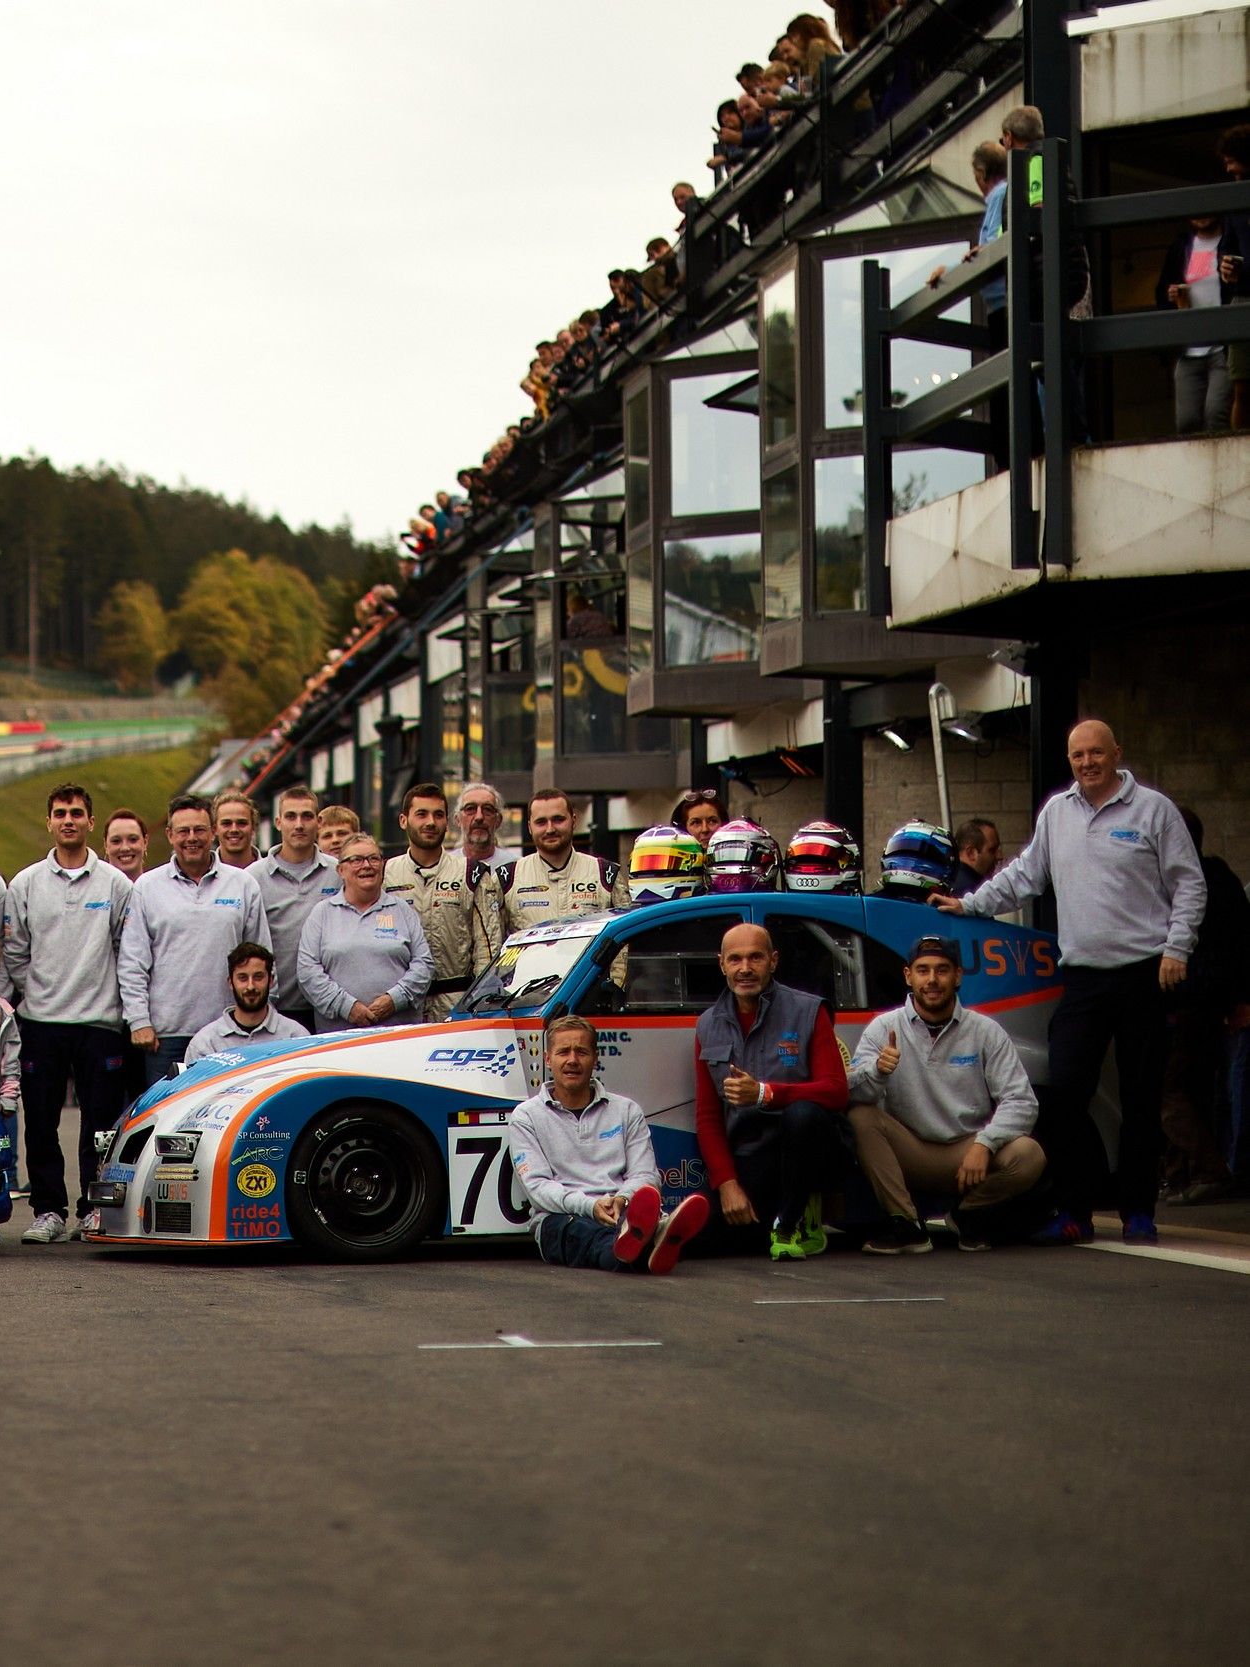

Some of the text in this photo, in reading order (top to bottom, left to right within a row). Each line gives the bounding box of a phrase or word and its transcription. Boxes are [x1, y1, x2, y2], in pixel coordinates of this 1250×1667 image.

[499, 1112, 507, 1121] B
[237, 1130, 290, 1140] SP Consulting
[238, 1146, 284, 1161] ARC
[246, 1175, 268, 1190] ZX1
[231, 1203, 280, 1219] ride4
